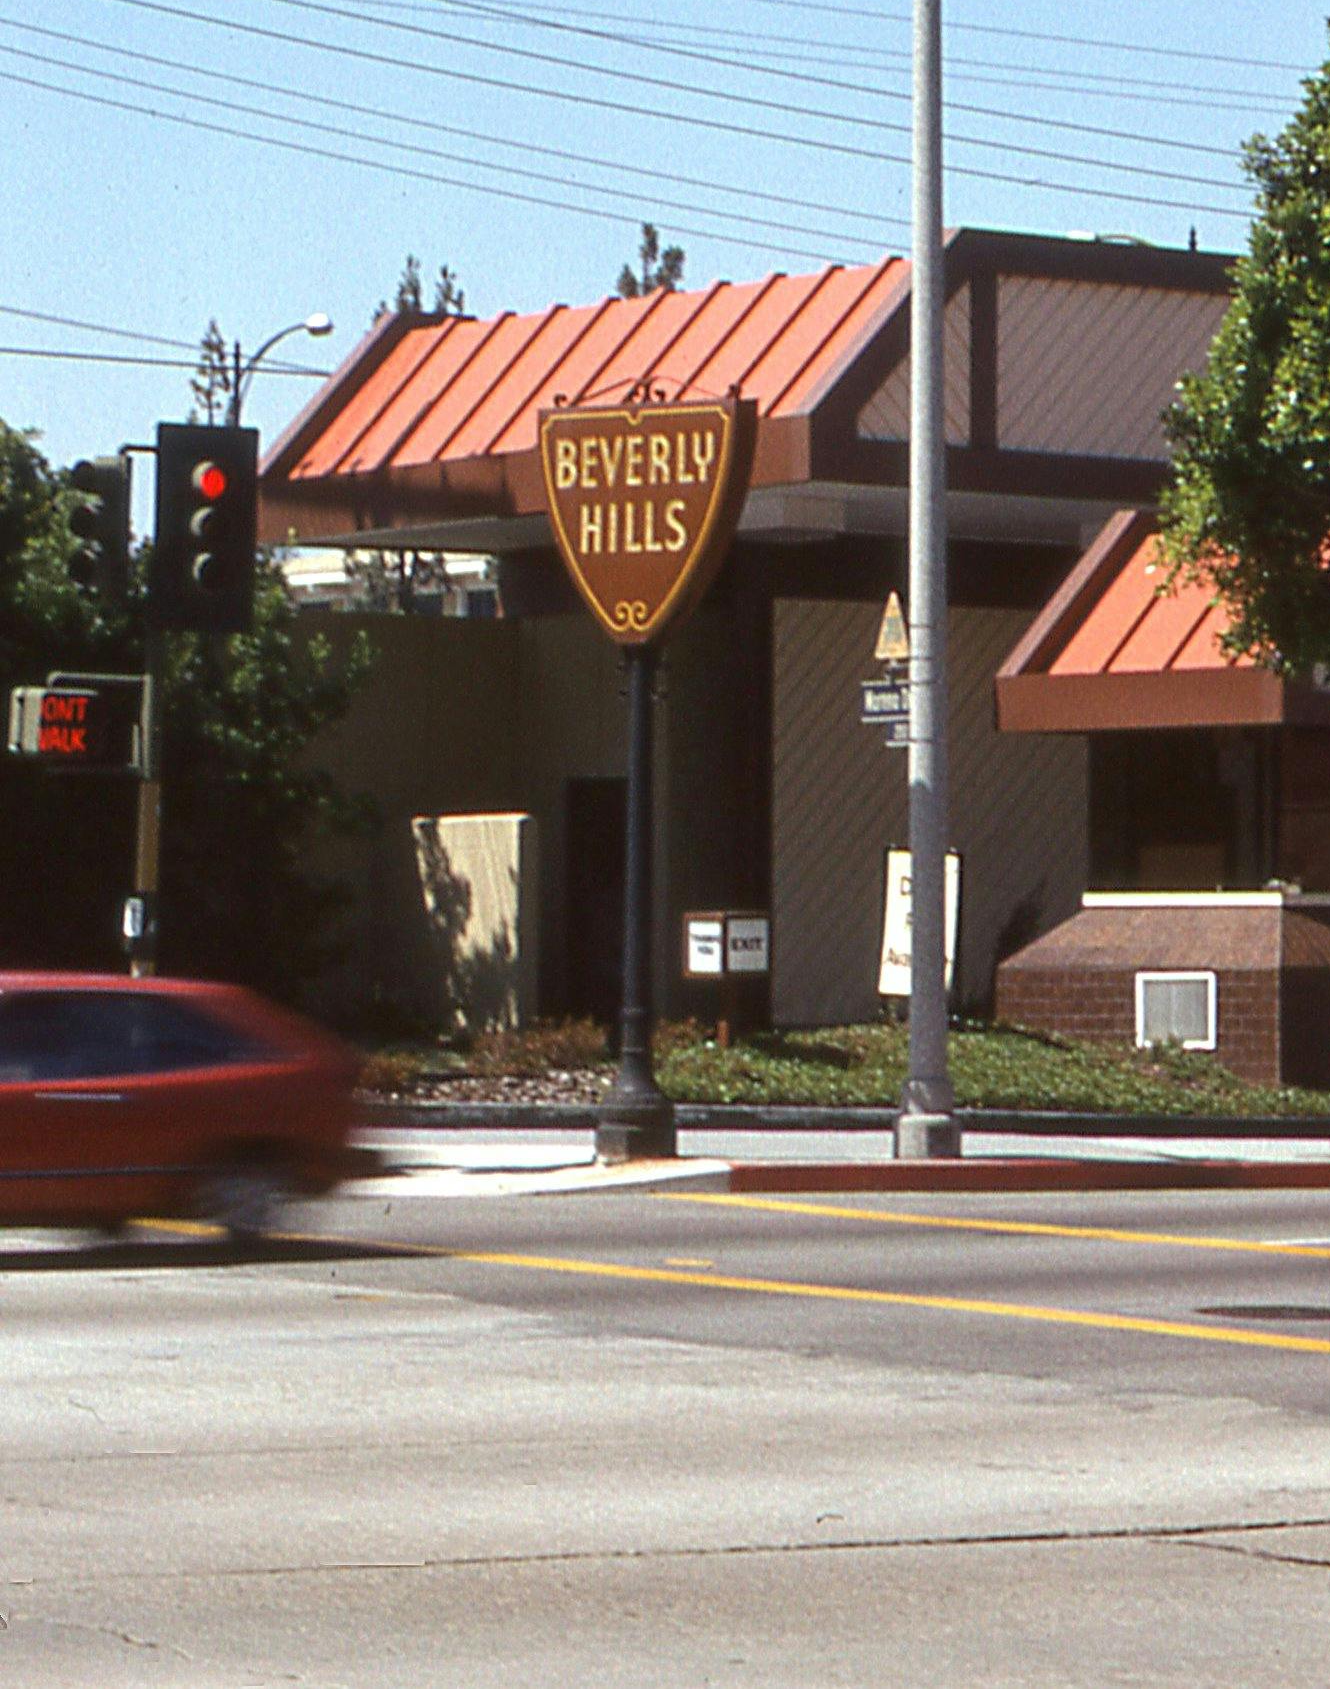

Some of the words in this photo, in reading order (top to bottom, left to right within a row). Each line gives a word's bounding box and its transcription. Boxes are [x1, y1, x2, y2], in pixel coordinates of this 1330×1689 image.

[555, 431, 715, 489] BEVERLY
[580, 499, 688, 554] HILLS
[40, 694, 89, 722] ONT
[731, 936, 764, 952] EXIT
